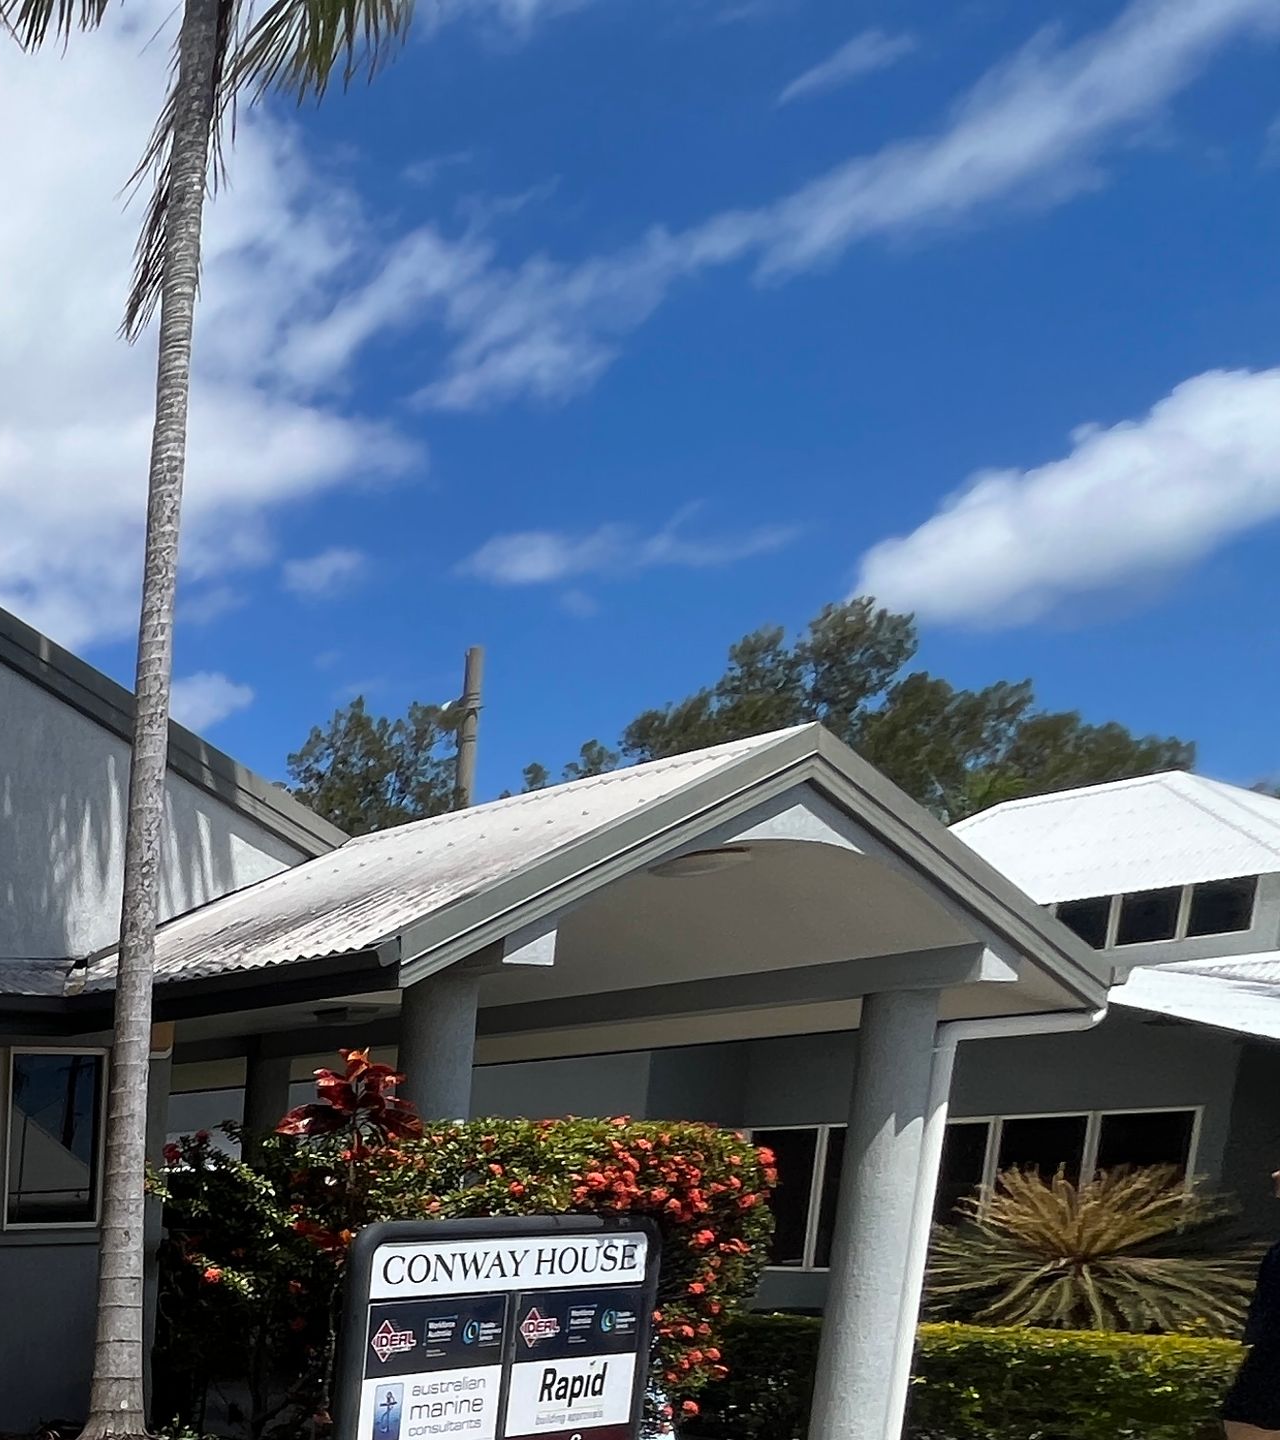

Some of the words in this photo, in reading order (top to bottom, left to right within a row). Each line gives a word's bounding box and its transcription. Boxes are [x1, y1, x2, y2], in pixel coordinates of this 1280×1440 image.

[382, 1249, 530, 1285] CONWAY
[534, 1243, 639, 1276] HOUSE
[411, 1376, 486, 1397] australian
[538, 1360, 608, 1408] Rapid
[409, 1395, 484, 1420] marine
[408, 1419, 482, 1437] consultants
